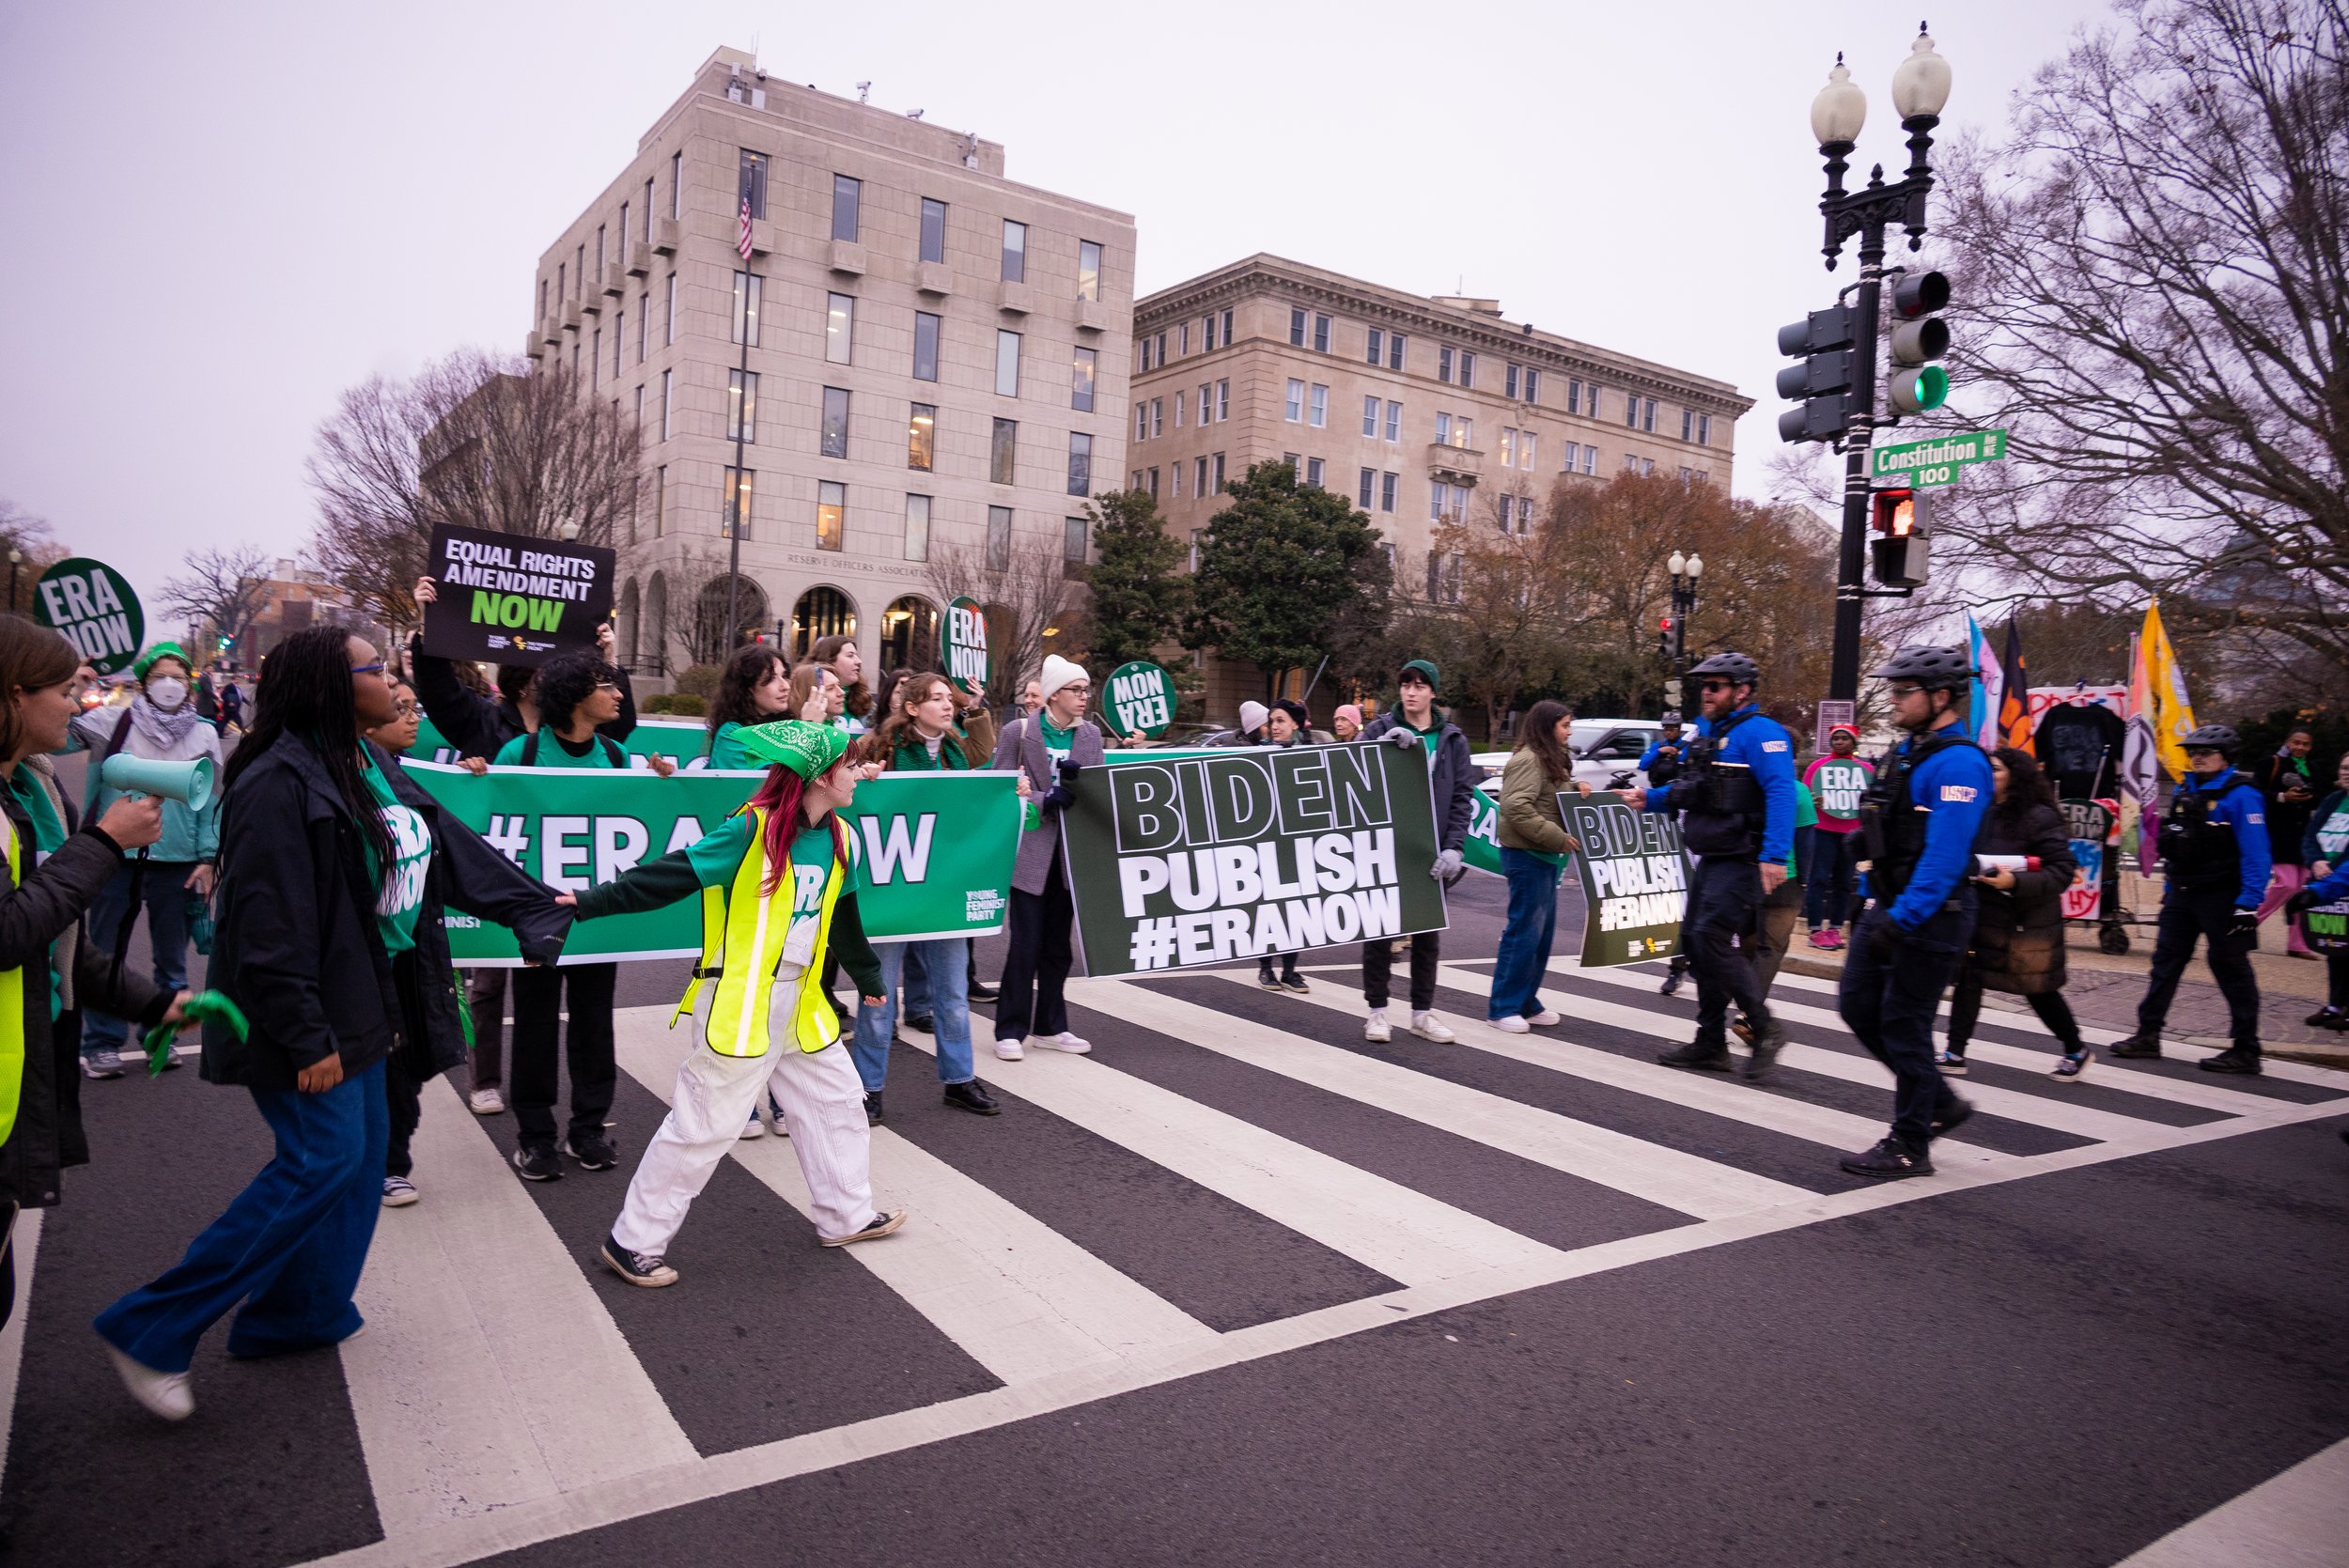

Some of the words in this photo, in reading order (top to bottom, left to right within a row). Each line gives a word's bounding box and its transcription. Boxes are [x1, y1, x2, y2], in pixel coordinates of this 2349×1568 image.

[1878, 439, 1976, 472] Constitution
[1983, 434, 1998, 445] Ave
[1919, 466, 1951, 485] 100
[445, 538, 517, 568] EQUAL
[519, 551, 596, 580] RIGHTS
[787, 553, 829, 567] RESERVE
[832, 559, 874, 572] OFFICERS
[39, 568, 124, 627] ERA
[443, 564, 593, 602] AMENDMENT
[470, 590, 567, 633] NOW
[949, 606, 988, 650] ERA
[56, 612, 135, 663] NOW
[950, 644, 988, 682] NOW
[1112, 669, 1165, 705] NOW
[1115, 695, 1171, 733] ERA
[1820, 766, 1868, 790] ERA
[1108, 744, 1393, 854] BIDEN
[383, 804, 432, 859] RA
[1573, 803, 1680, 859] BIDEN
[2070, 821, 2106, 839] OW
[1117, 828, 1399, 919] PUBLISH
[1588, 854, 1688, 898] PUBLISH
[966, 898, 1005, 911] FEMINIST
[966, 909, 996, 922] PARTY
[1128, 886, 1402, 972] #ERANOW
